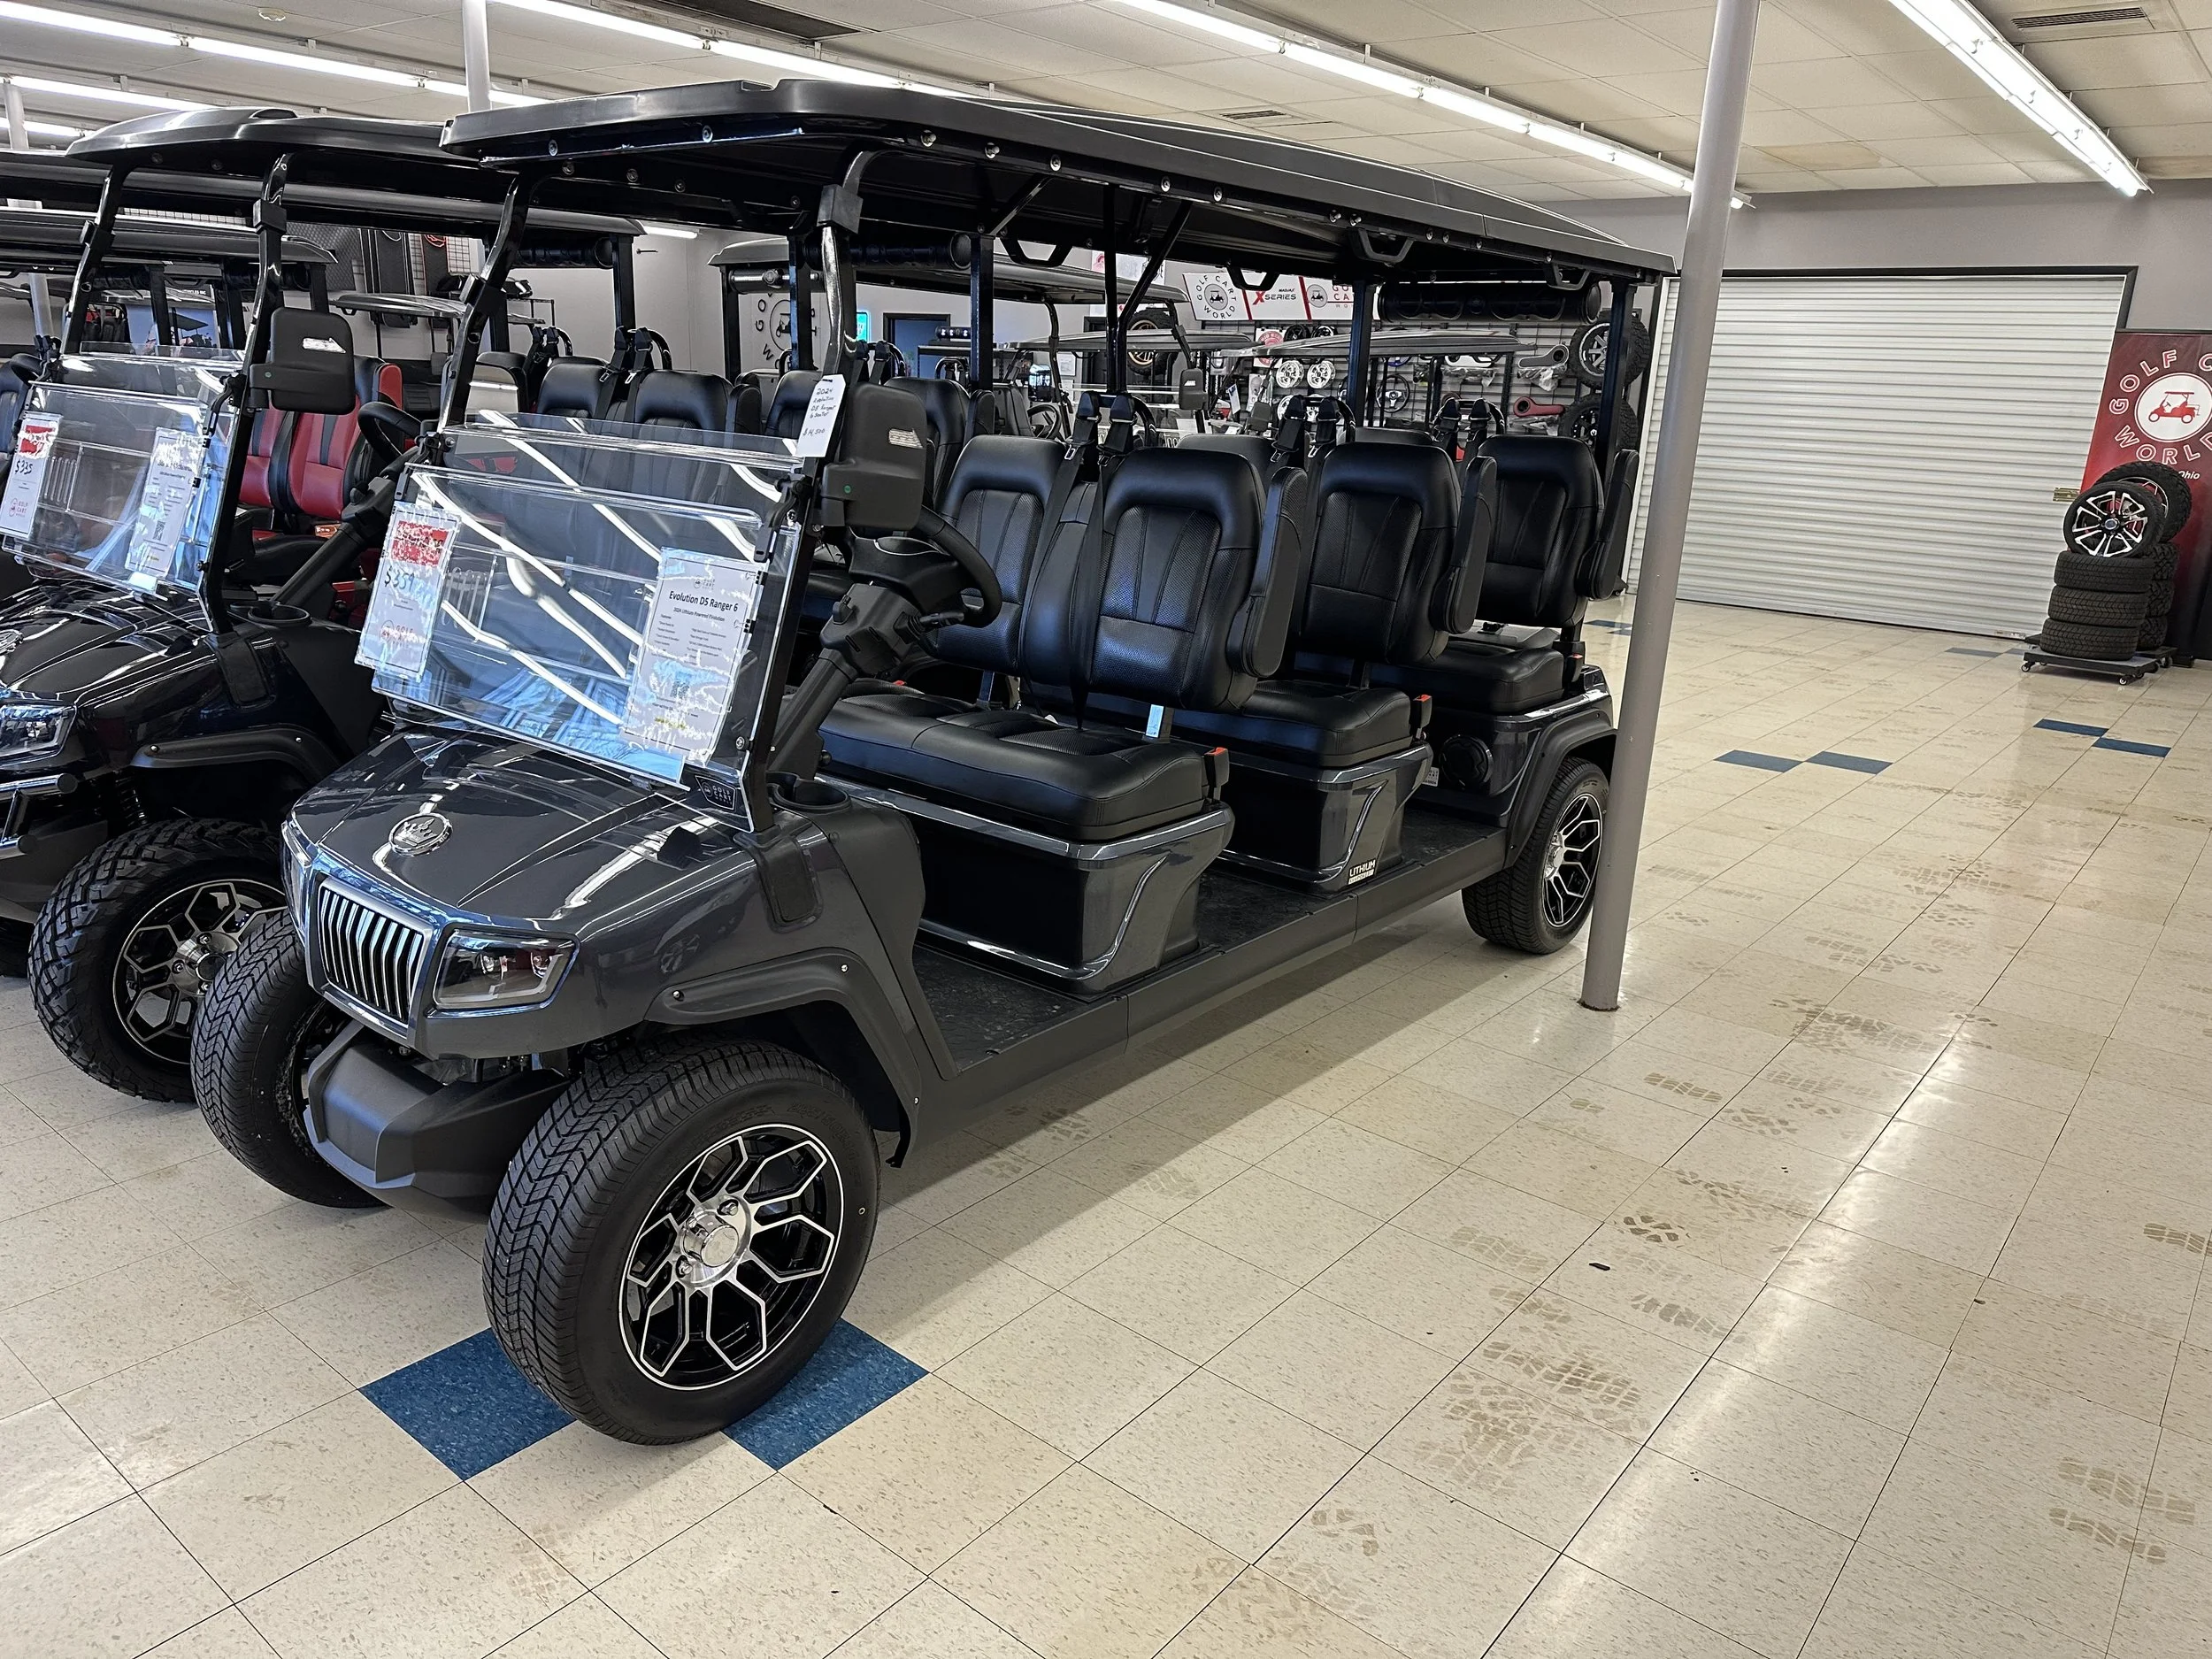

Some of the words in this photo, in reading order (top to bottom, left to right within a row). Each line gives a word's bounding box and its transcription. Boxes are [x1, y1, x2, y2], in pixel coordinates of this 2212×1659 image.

[1196, 274, 1209, 301] GOLF
[1215, 275, 1237, 302] CART
[1203, 304, 1236, 319] WORLD
[2109, 349, 2177, 415] GOLF
[669, 590, 699, 604] Evolution
[699, 596, 710, 605] D5
[710, 598, 733, 611] Ranger
[1349, 859, 1376, 877] LITHIUM
